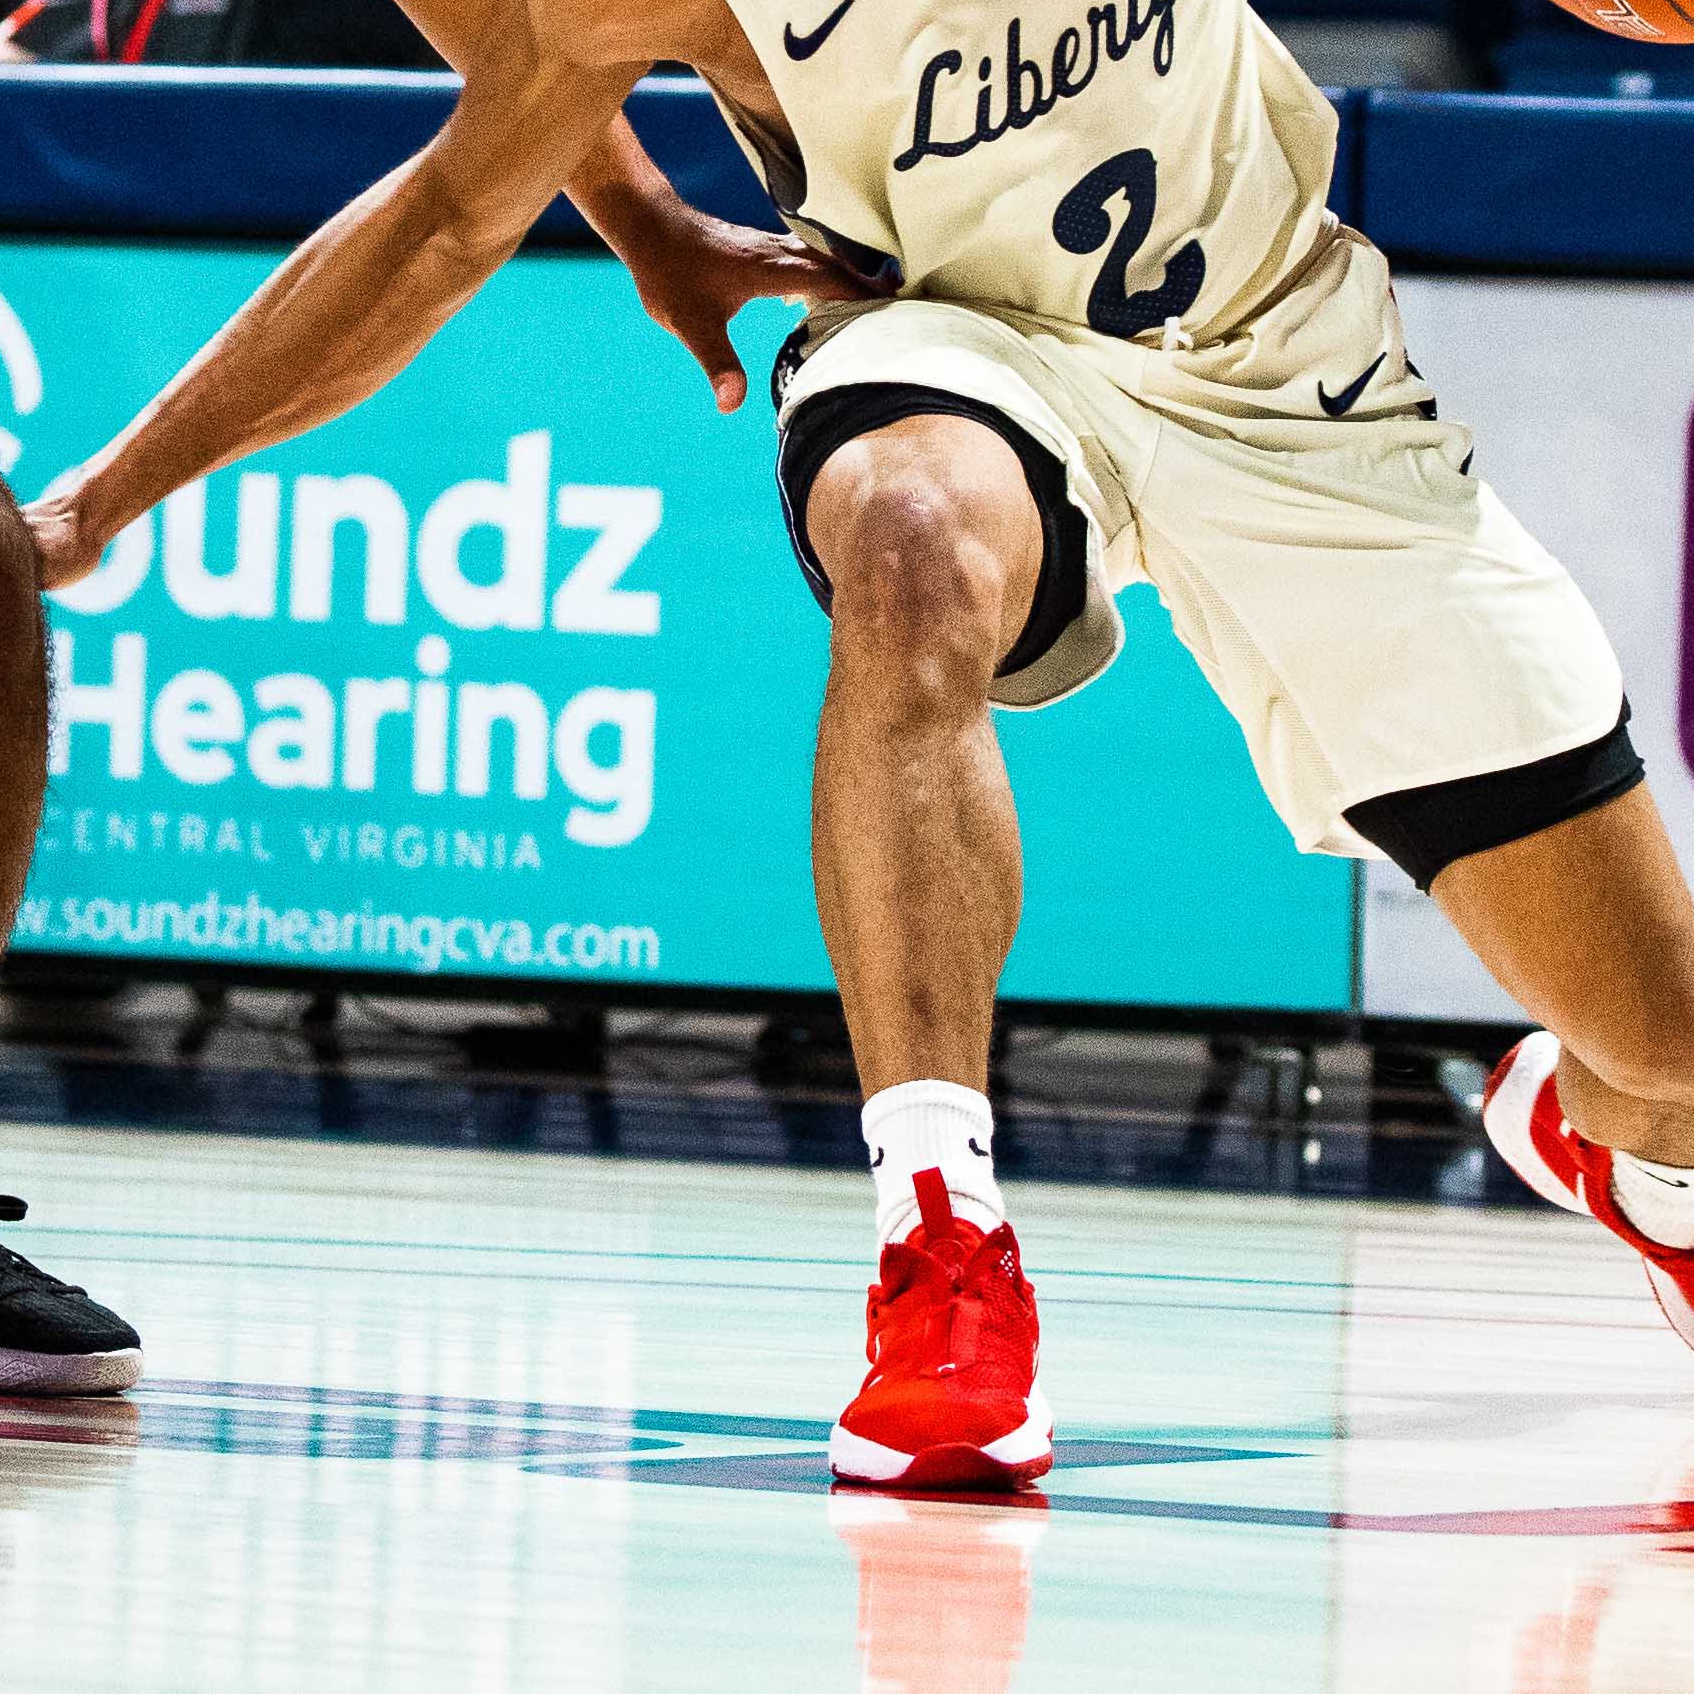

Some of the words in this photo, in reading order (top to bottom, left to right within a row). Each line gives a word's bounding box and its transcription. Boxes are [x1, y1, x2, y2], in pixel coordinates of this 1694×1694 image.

[1052, 147, 1207, 339] 2
[48, 629, 657, 850] Hearing
[304, 820, 543, 871] VIRGINIA
